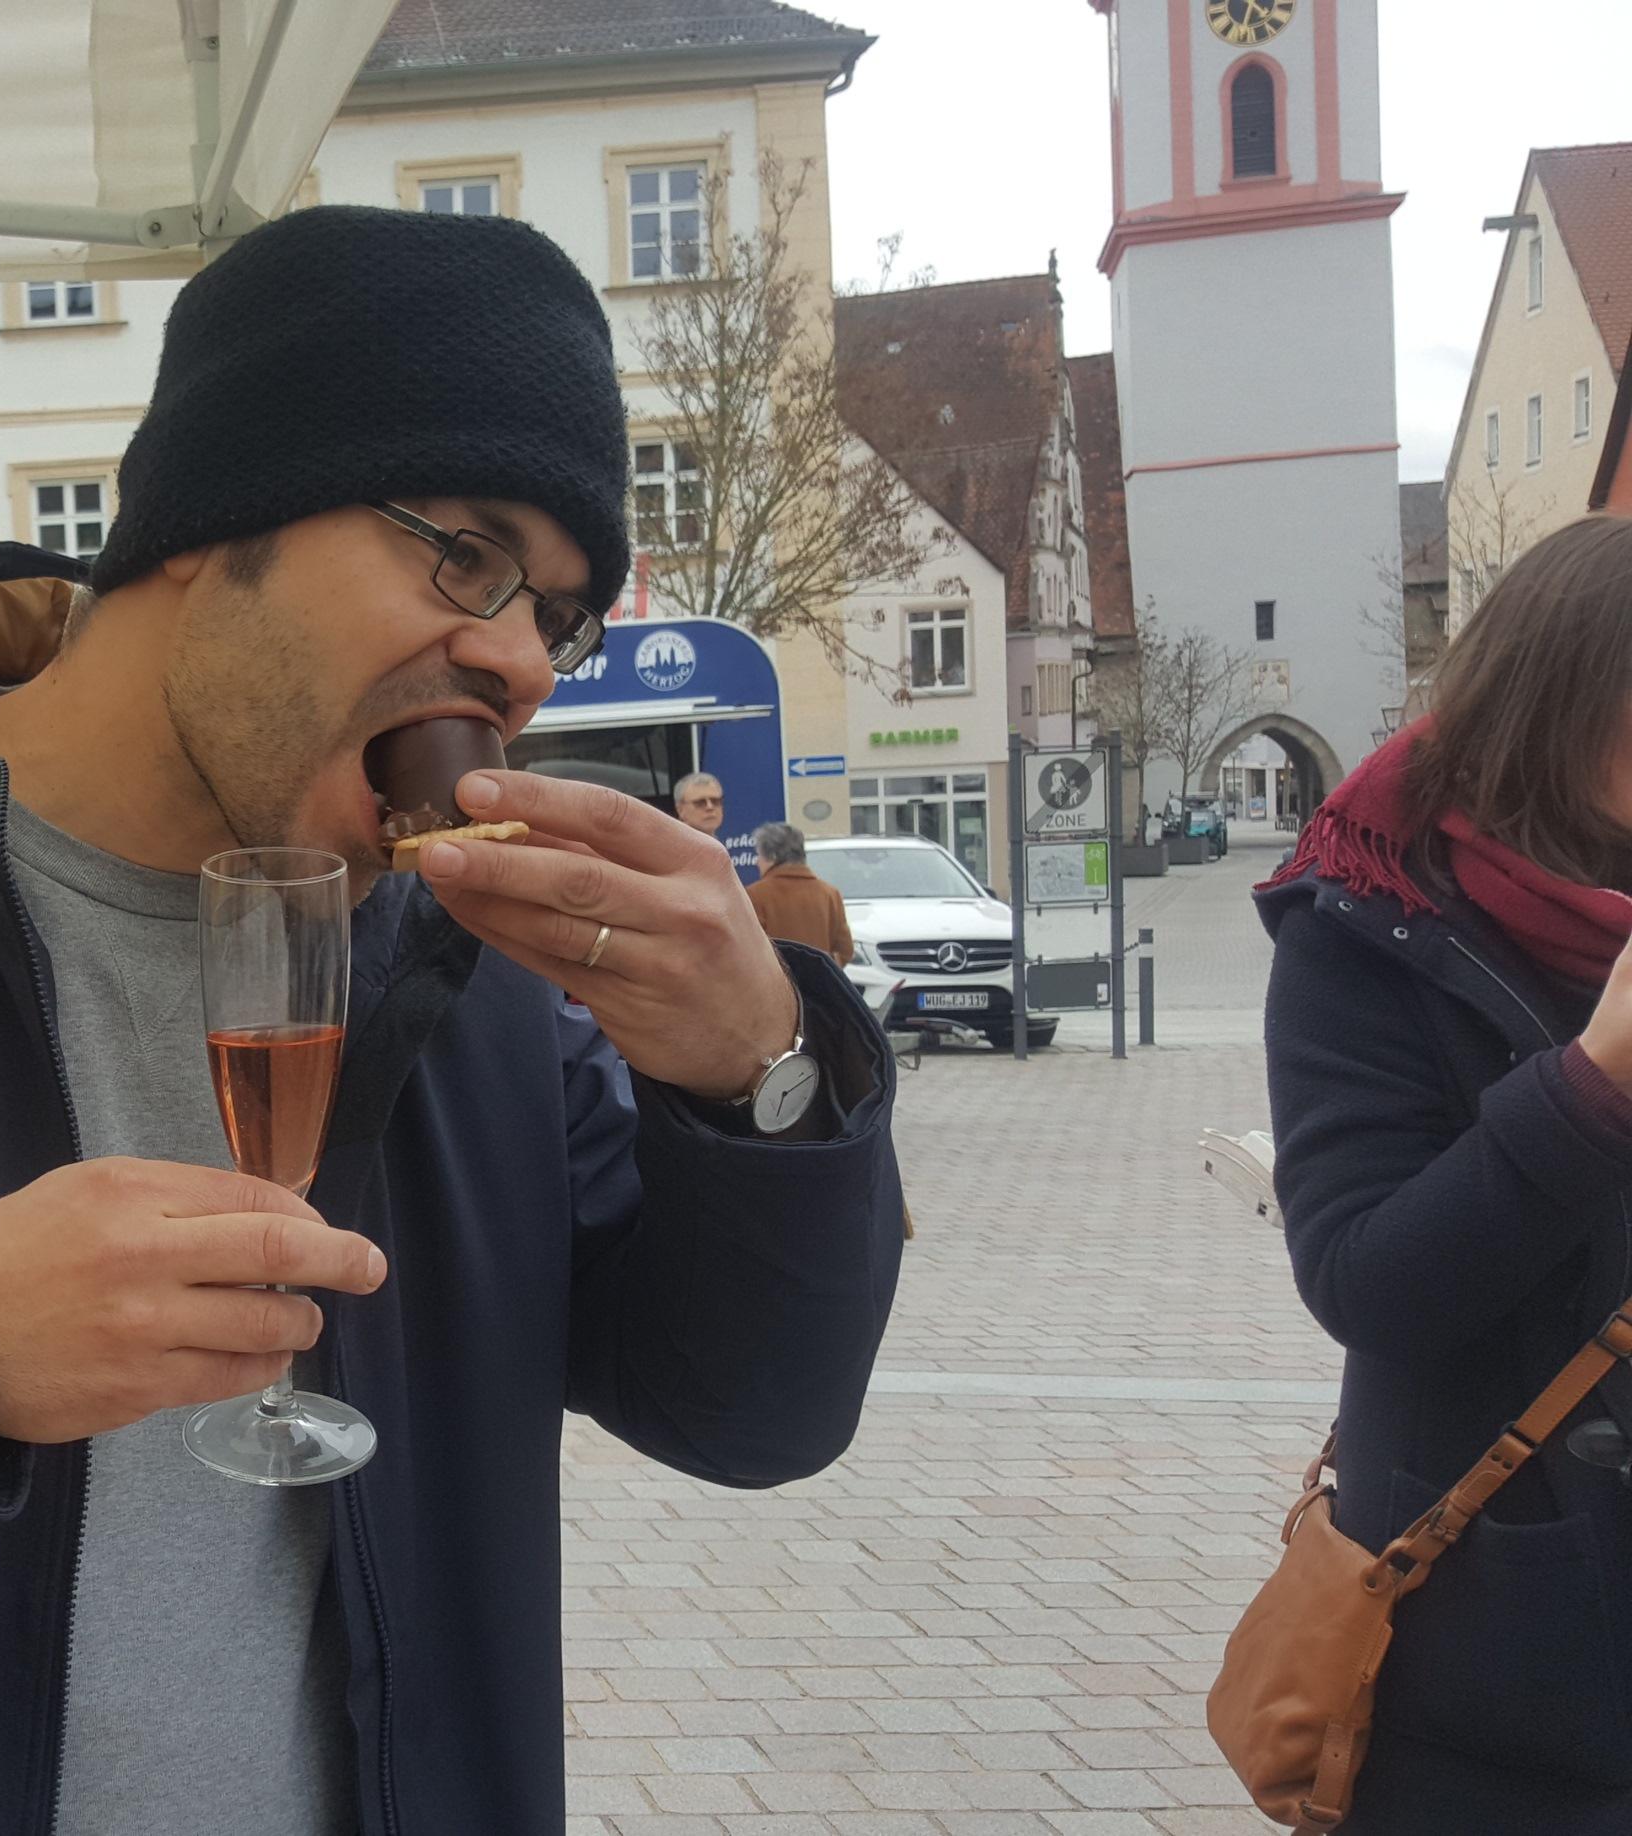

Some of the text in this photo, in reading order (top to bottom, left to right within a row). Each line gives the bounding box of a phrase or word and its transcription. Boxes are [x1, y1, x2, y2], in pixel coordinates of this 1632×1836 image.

[642, 662, 692, 688] HERZOG
[869, 728, 959, 746] BARMER
[1045, 813, 1087, 828] ZONE
[925, 994, 946, 1007] WUG
[968, 994, 987, 1007] 119
